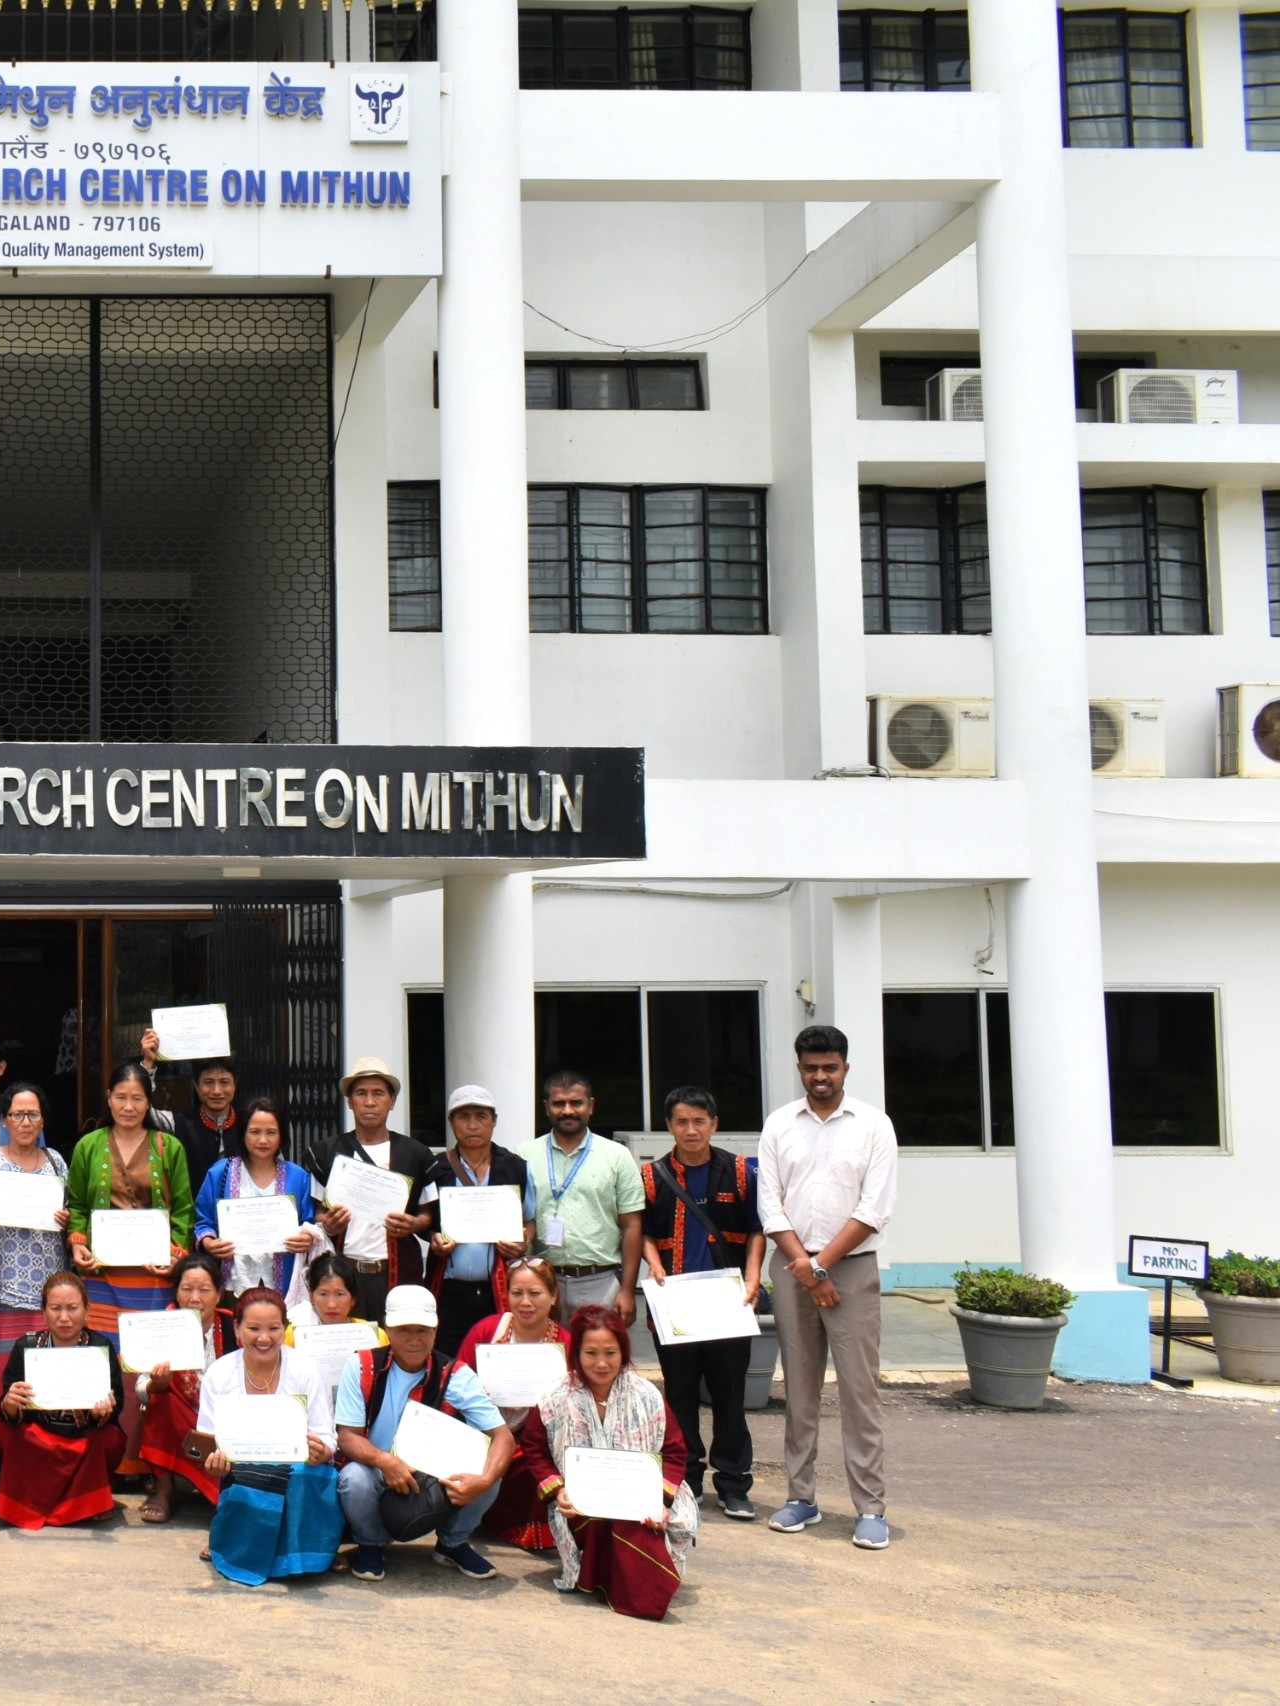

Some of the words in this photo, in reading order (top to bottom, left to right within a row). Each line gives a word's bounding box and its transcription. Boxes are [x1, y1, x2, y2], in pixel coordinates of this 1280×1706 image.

[90, 76, 250, 131] अनुसंधान
[263, 72, 326, 120] केंद्र
[74, 142, 171, 164] ७९७१०६
[79, 168, 209, 206] CENTRE
[221, 169, 266, 206] ON
[280, 170, 411, 207] MITHUN
[92, 216, 161, 231] 797106
[2, 242, 50, 260] Quality
[54, 243, 145, 260] Management
[148, 243, 204, 260] System)
[105, 767, 308, 829] CENTRE
[314, 768, 389, 834] ON
[401, 770, 584, 834] MITHUN
[1162, 1246, 1178, 1256] NO
[1143, 1255, 1198, 1272] PARKING
